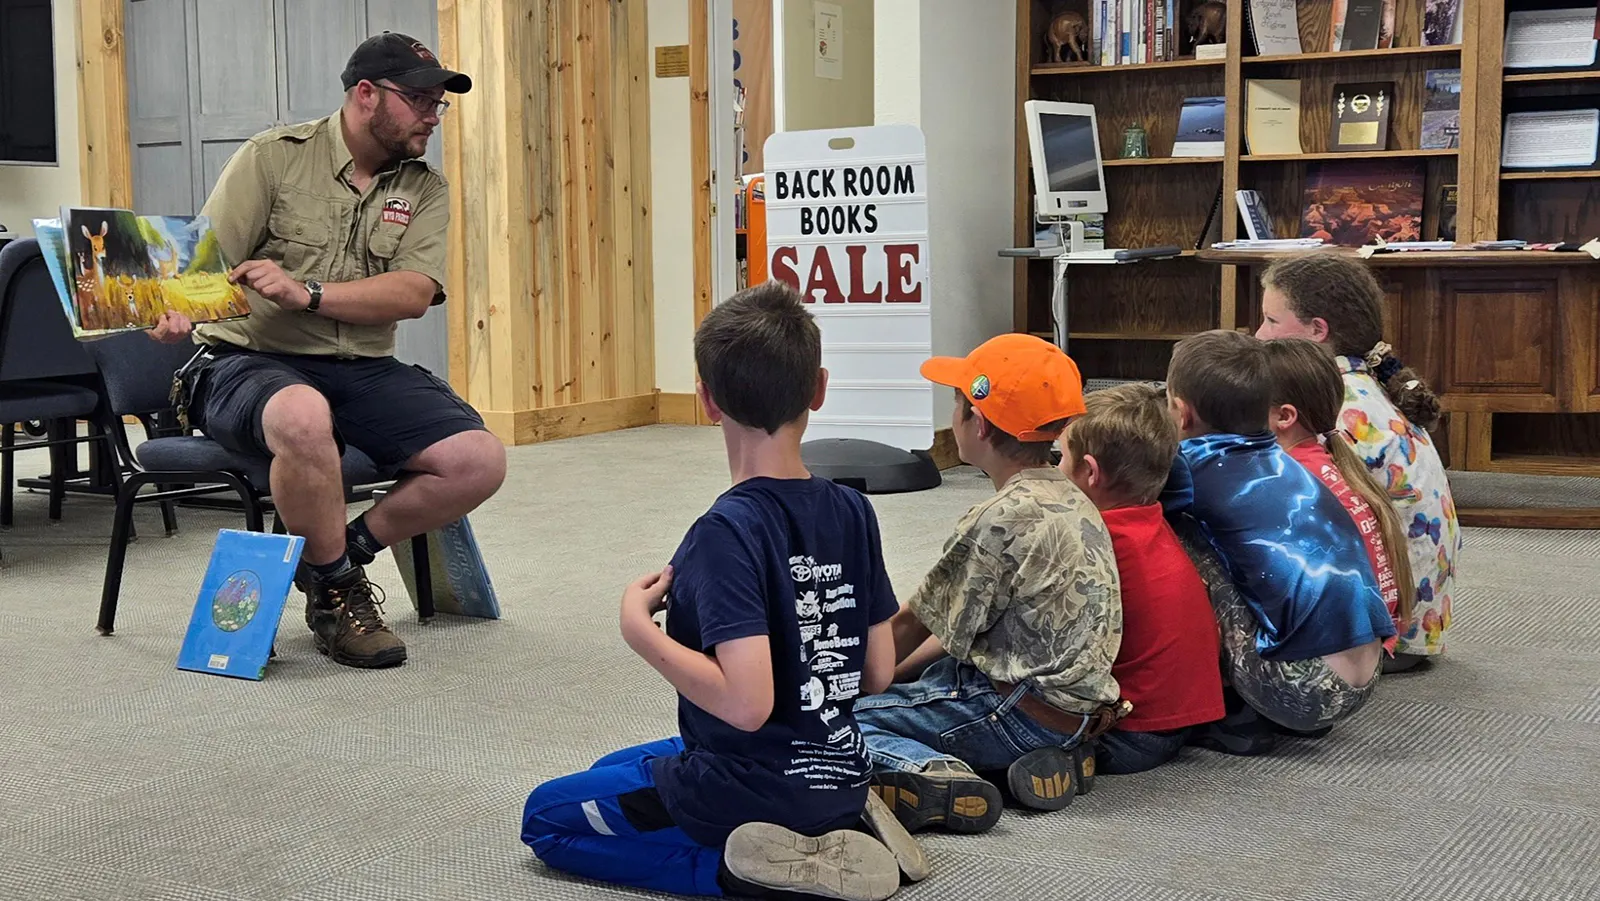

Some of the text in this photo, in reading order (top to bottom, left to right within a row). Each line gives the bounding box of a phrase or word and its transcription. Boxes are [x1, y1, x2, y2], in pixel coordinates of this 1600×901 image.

[775, 165, 915, 199] BACK ROOM
[800, 204, 878, 235] BOOKS
[771, 244, 922, 303] SALE
